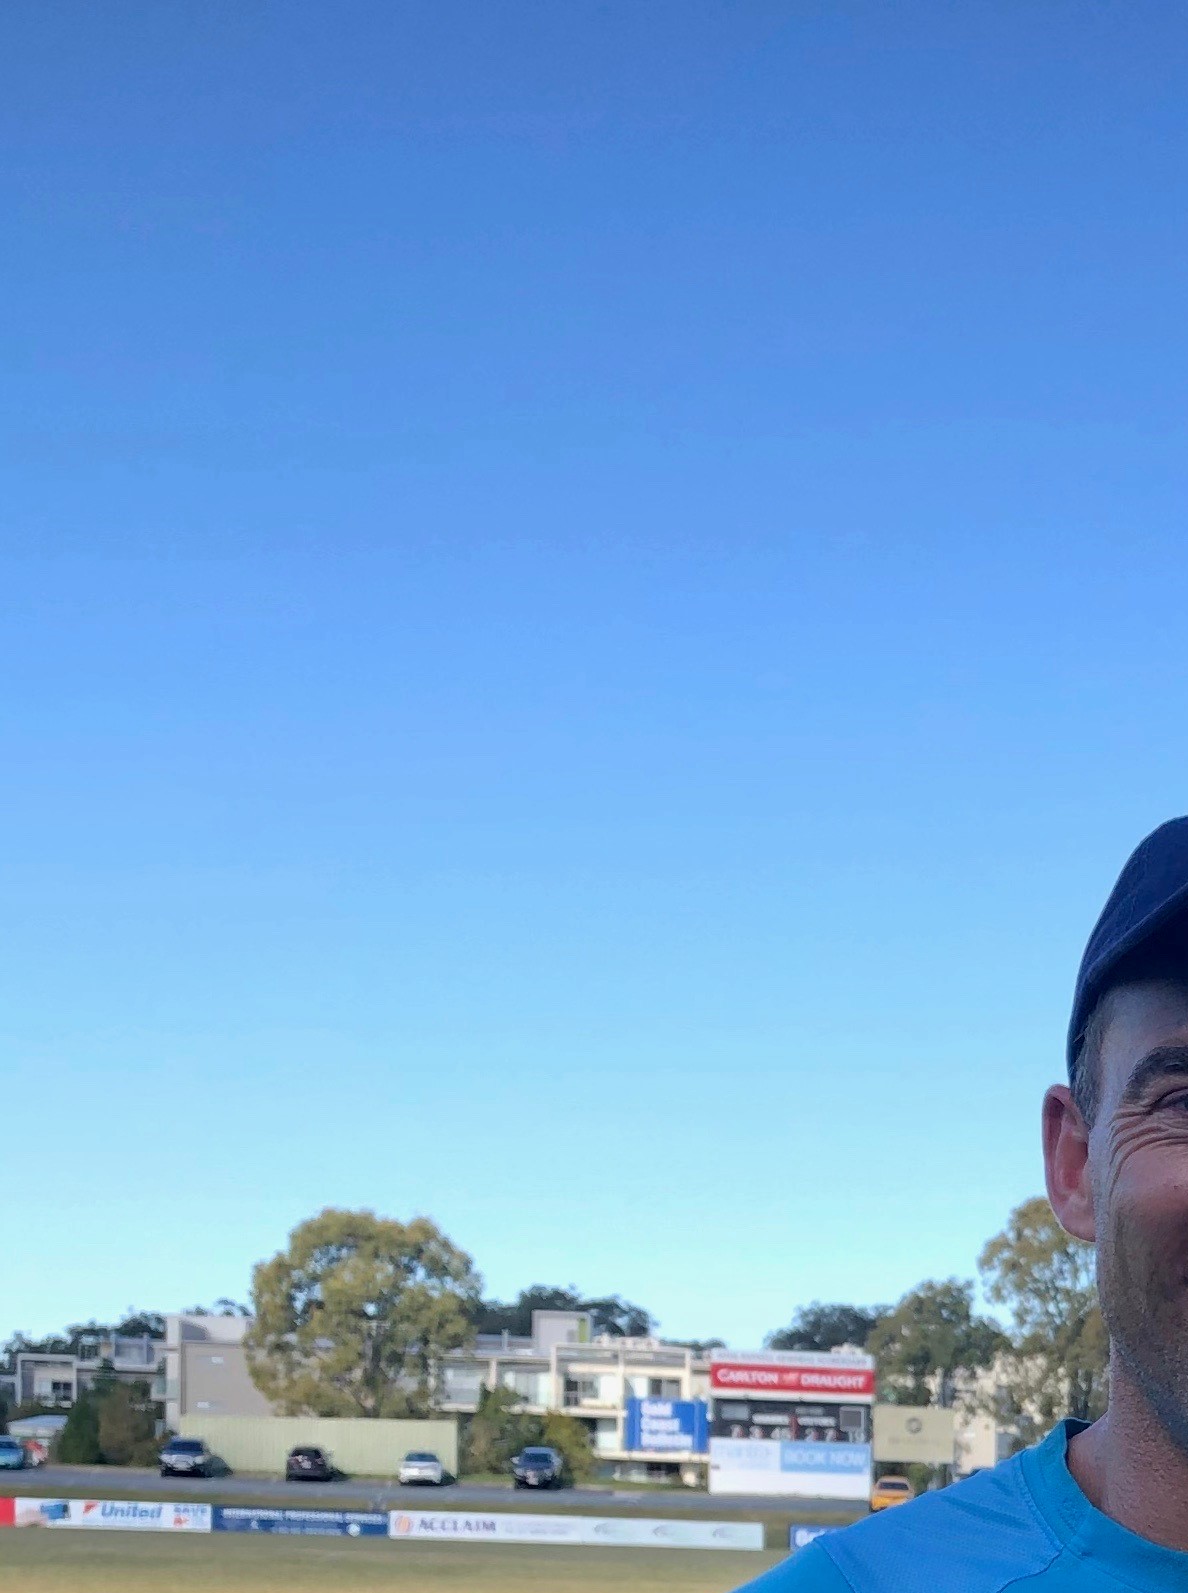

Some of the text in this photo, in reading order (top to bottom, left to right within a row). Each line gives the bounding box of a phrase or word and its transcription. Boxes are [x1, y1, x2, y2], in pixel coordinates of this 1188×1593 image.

[716, 1367, 779, 1385] CARLTON
[800, 1373, 866, 1389] DRAUGHT
[101, 1502, 163, 1519] United
